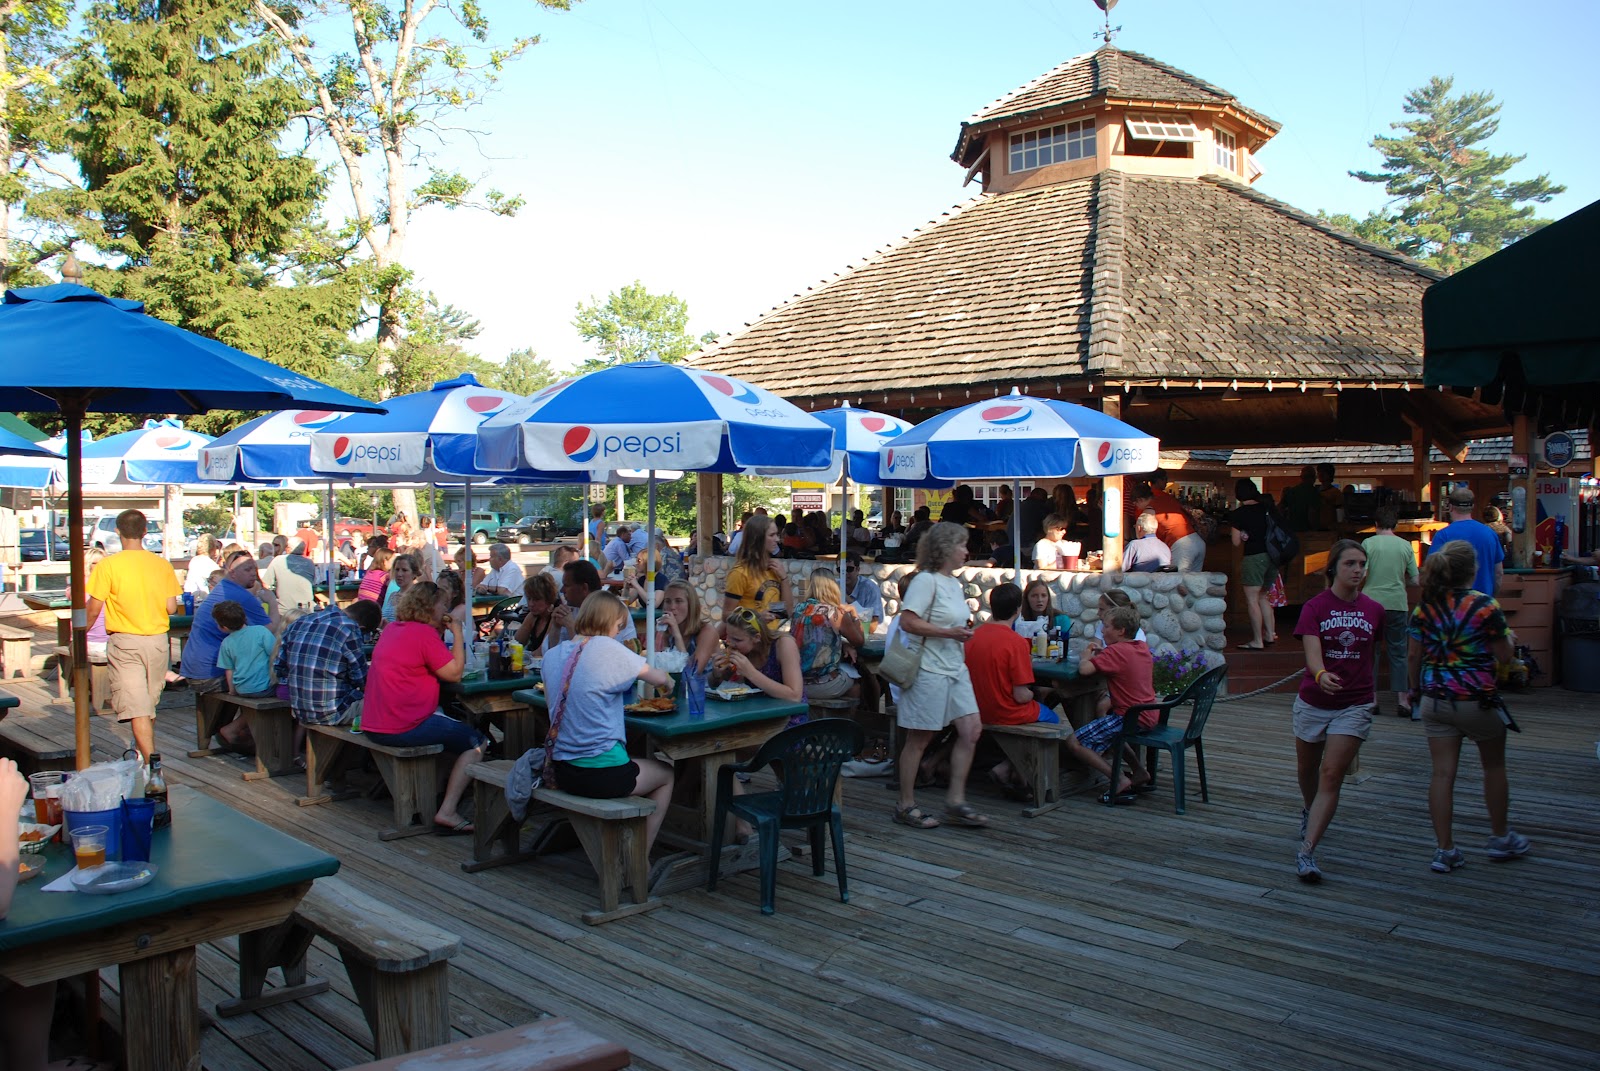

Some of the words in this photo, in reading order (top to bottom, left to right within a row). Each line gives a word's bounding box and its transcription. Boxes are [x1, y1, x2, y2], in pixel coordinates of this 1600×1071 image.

[744, 407, 786, 419] pepsi
[978, 425, 1029, 434] pepsi
[603, 431, 680, 457] pepsi
[354, 444, 401, 463] pepsi
[895, 453, 916, 468] pepsi
[1115, 447, 1143, 464] peps
[592, 488, 604, 498] 35
[1544, 482, 1567, 494] Bull
[1320, 616, 1373, 635] BOONEDOCKS
